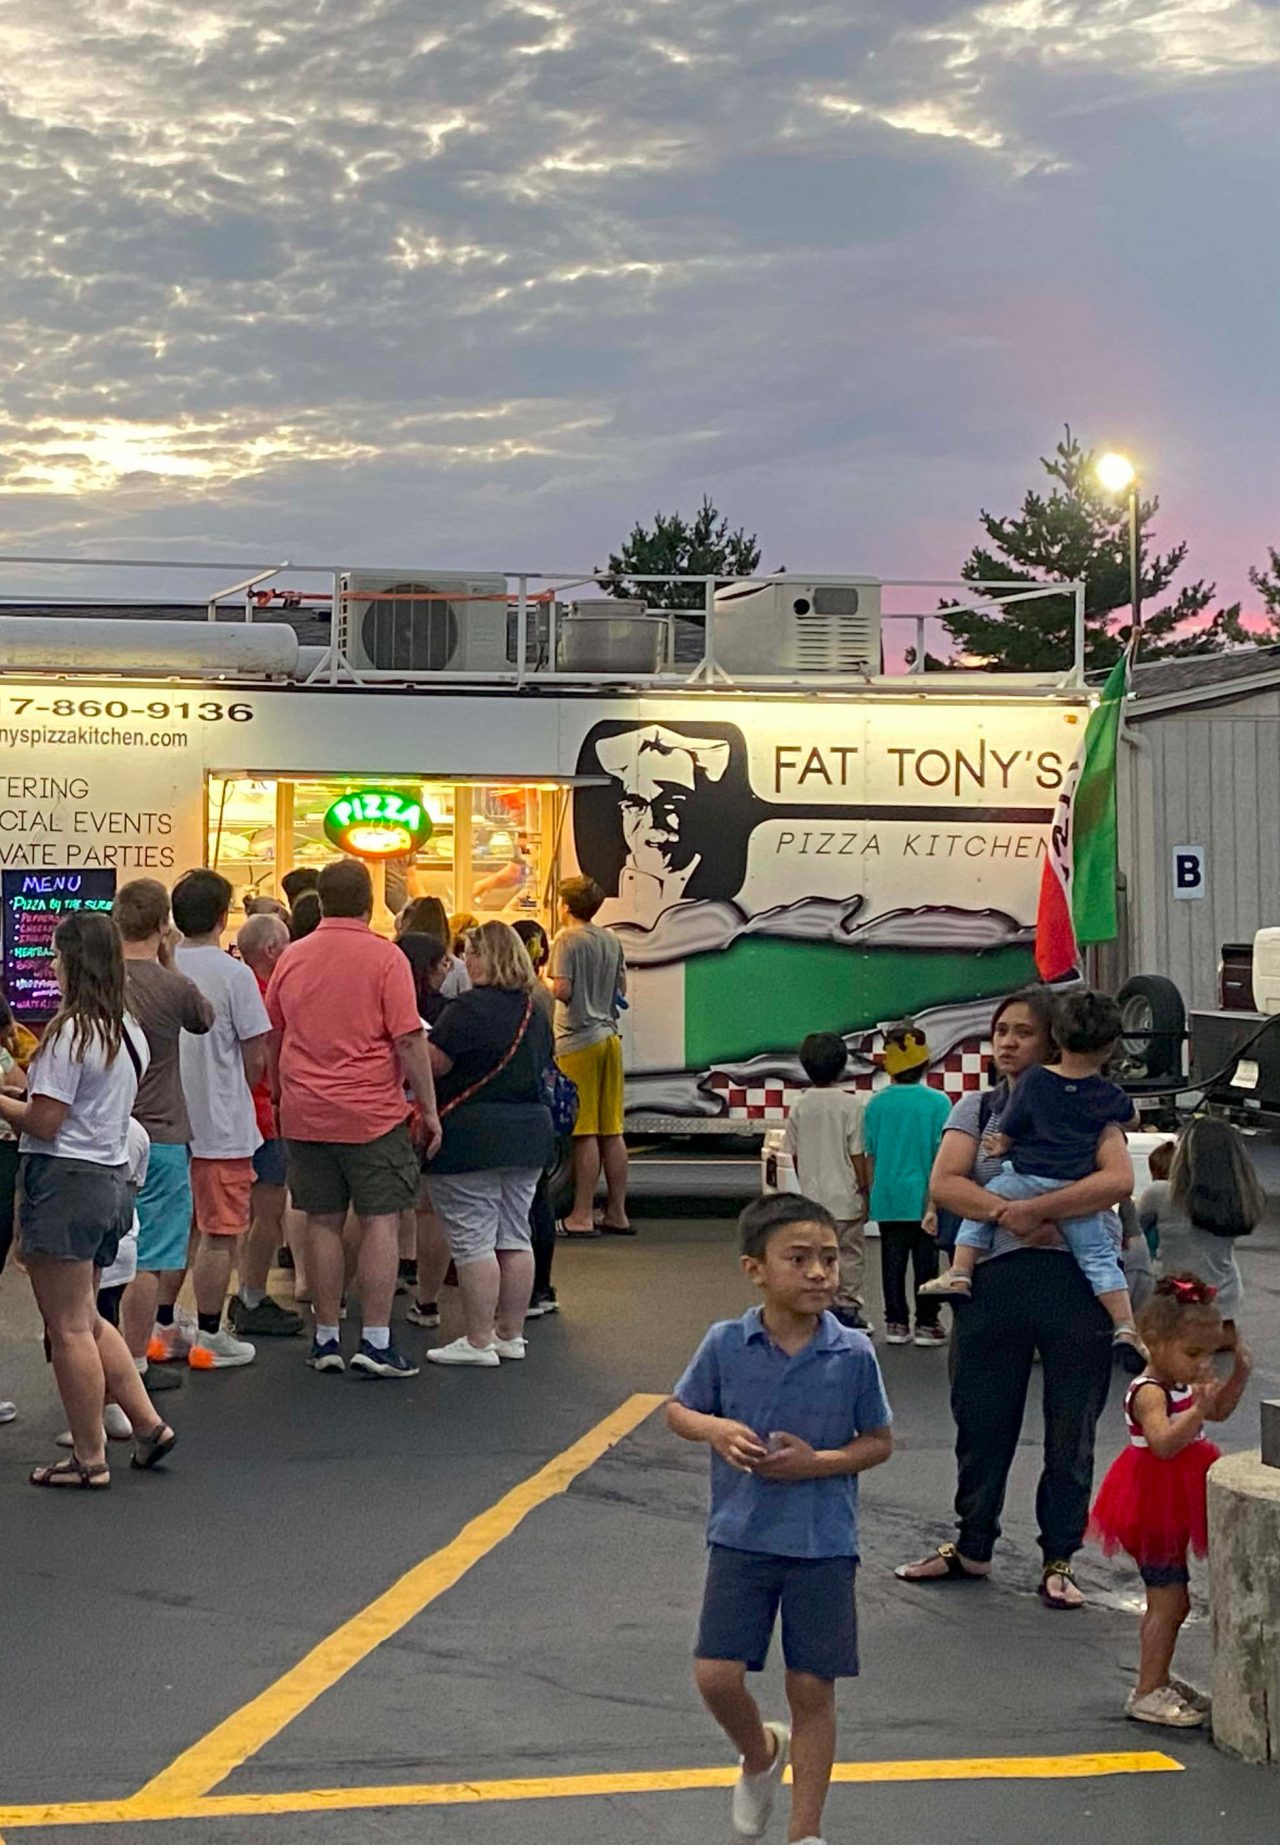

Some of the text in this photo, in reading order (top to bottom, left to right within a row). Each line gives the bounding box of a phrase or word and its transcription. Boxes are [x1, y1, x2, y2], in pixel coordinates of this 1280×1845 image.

[775, 739, 1063, 796] FAT TONY'S
[74, 811, 172, 834] EVENTS
[333, 794, 421, 831] PIZZA
[776, 832, 880, 855] PIZZA
[67, 845, 174, 867] PARTIES
[1177, 855, 1201, 888] B
[22, 875, 82, 893] MENU
